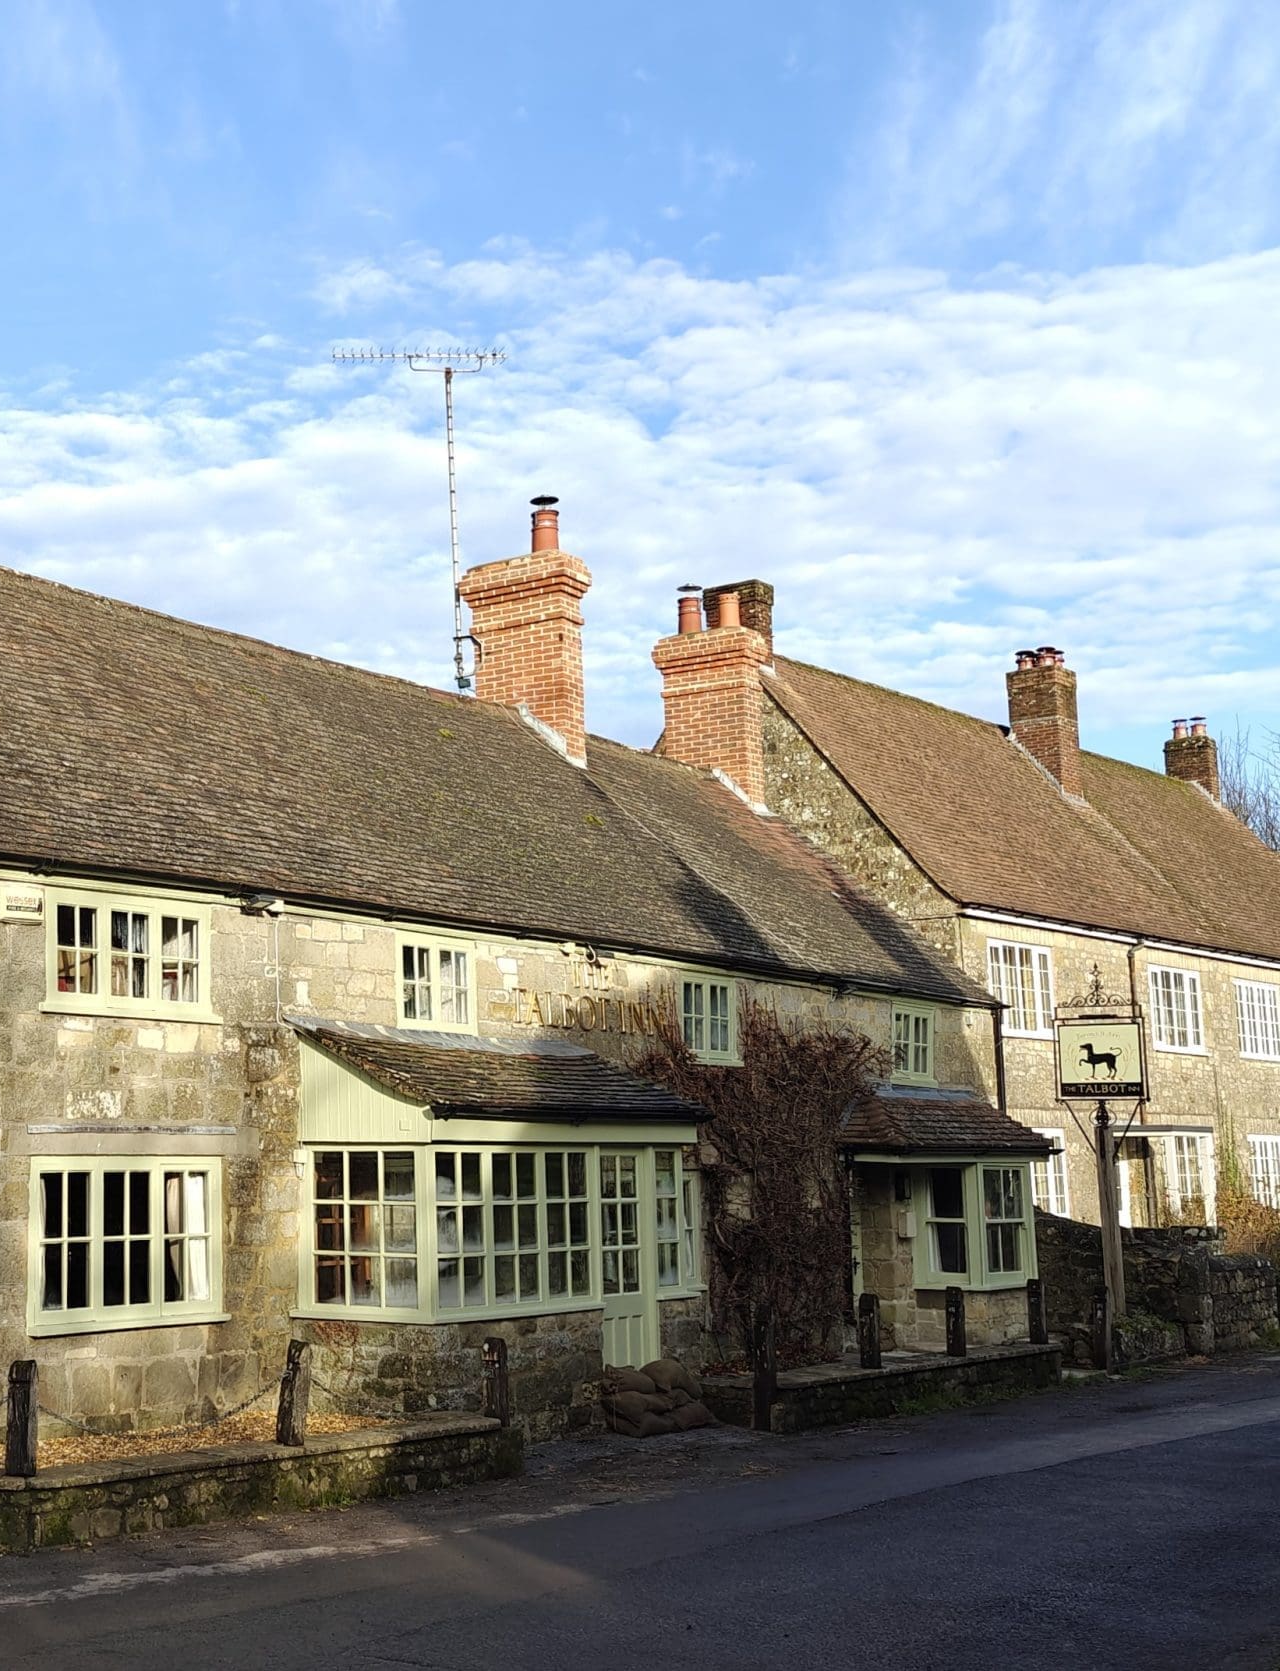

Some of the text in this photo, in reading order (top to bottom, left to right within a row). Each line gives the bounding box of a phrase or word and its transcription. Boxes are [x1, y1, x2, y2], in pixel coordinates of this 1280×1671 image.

[571, 960, 610, 992] THE
[512, 987, 666, 1037] TALBOT INN
[1078, 1084, 1127, 1093] TALBOT
